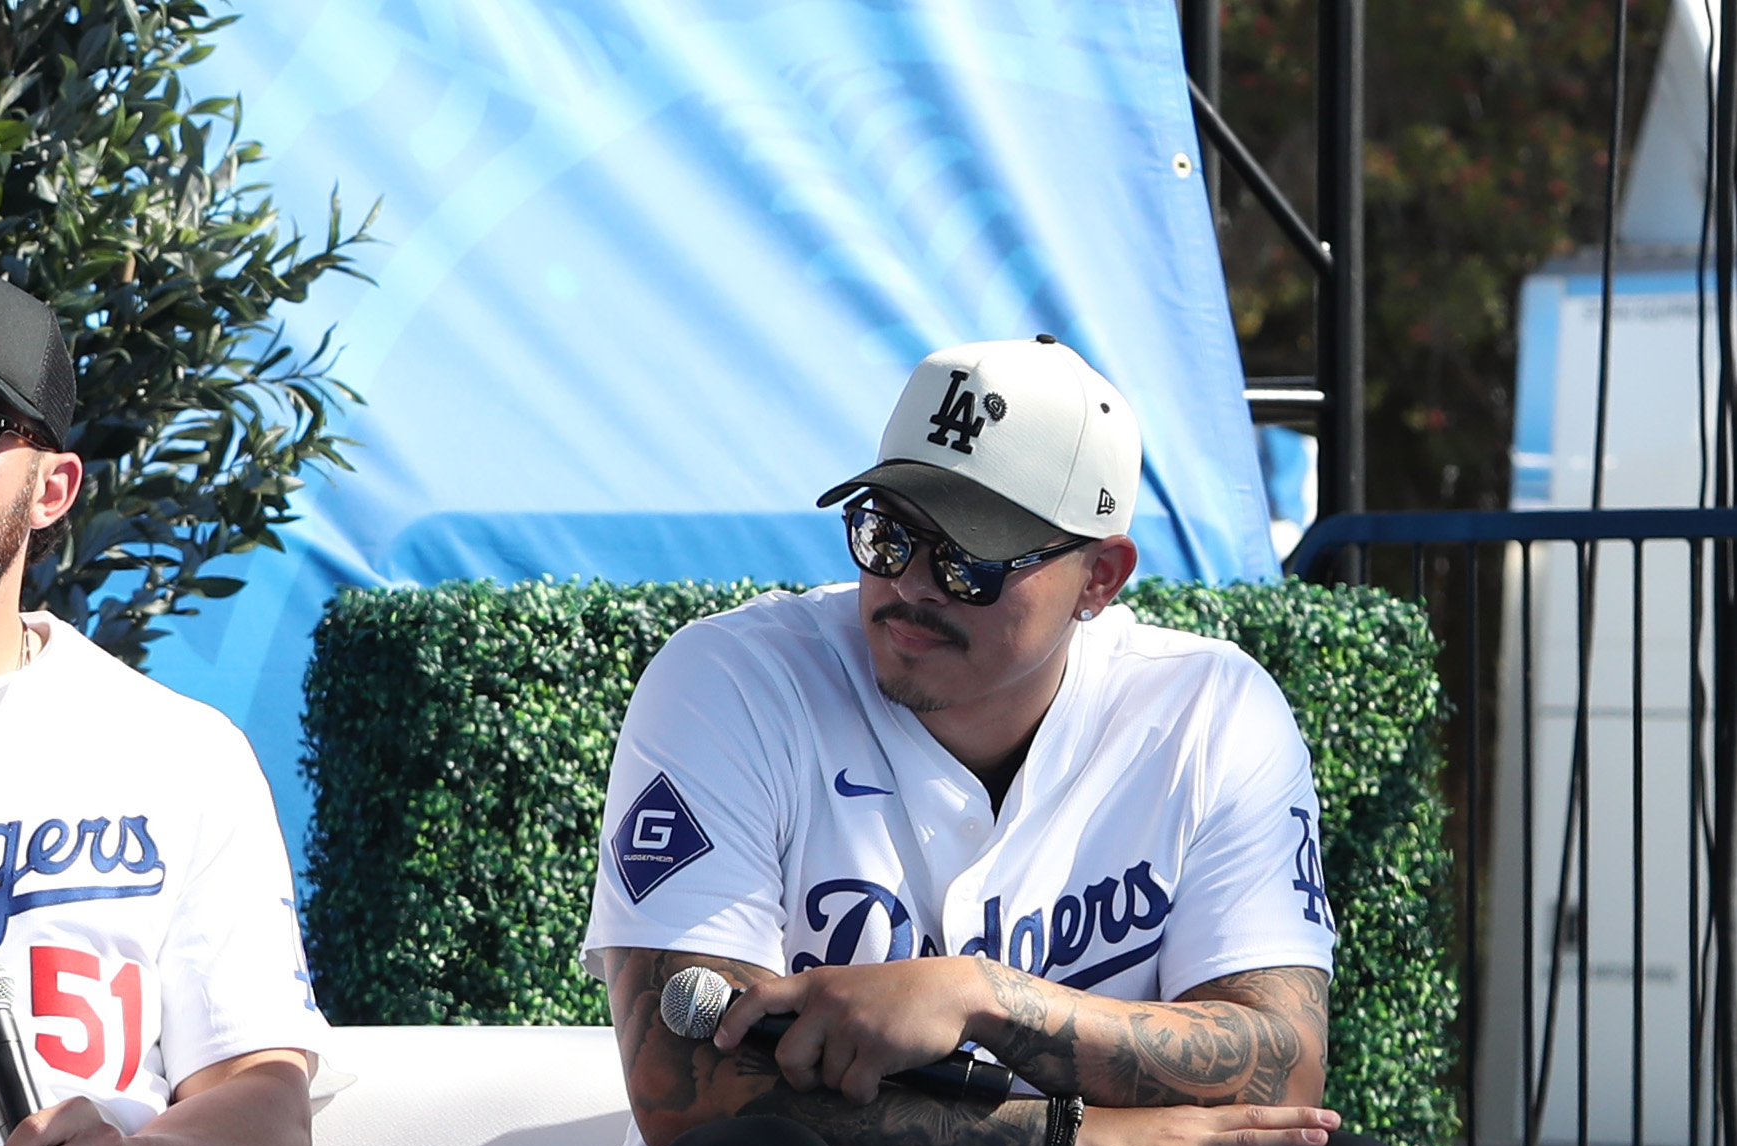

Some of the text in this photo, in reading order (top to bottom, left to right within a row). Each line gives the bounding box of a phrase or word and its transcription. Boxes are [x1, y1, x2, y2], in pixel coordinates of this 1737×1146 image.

[927, 370, 986, 455] LA
[632, 809, 677, 850] G
[30, 945, 143, 1092] 51
